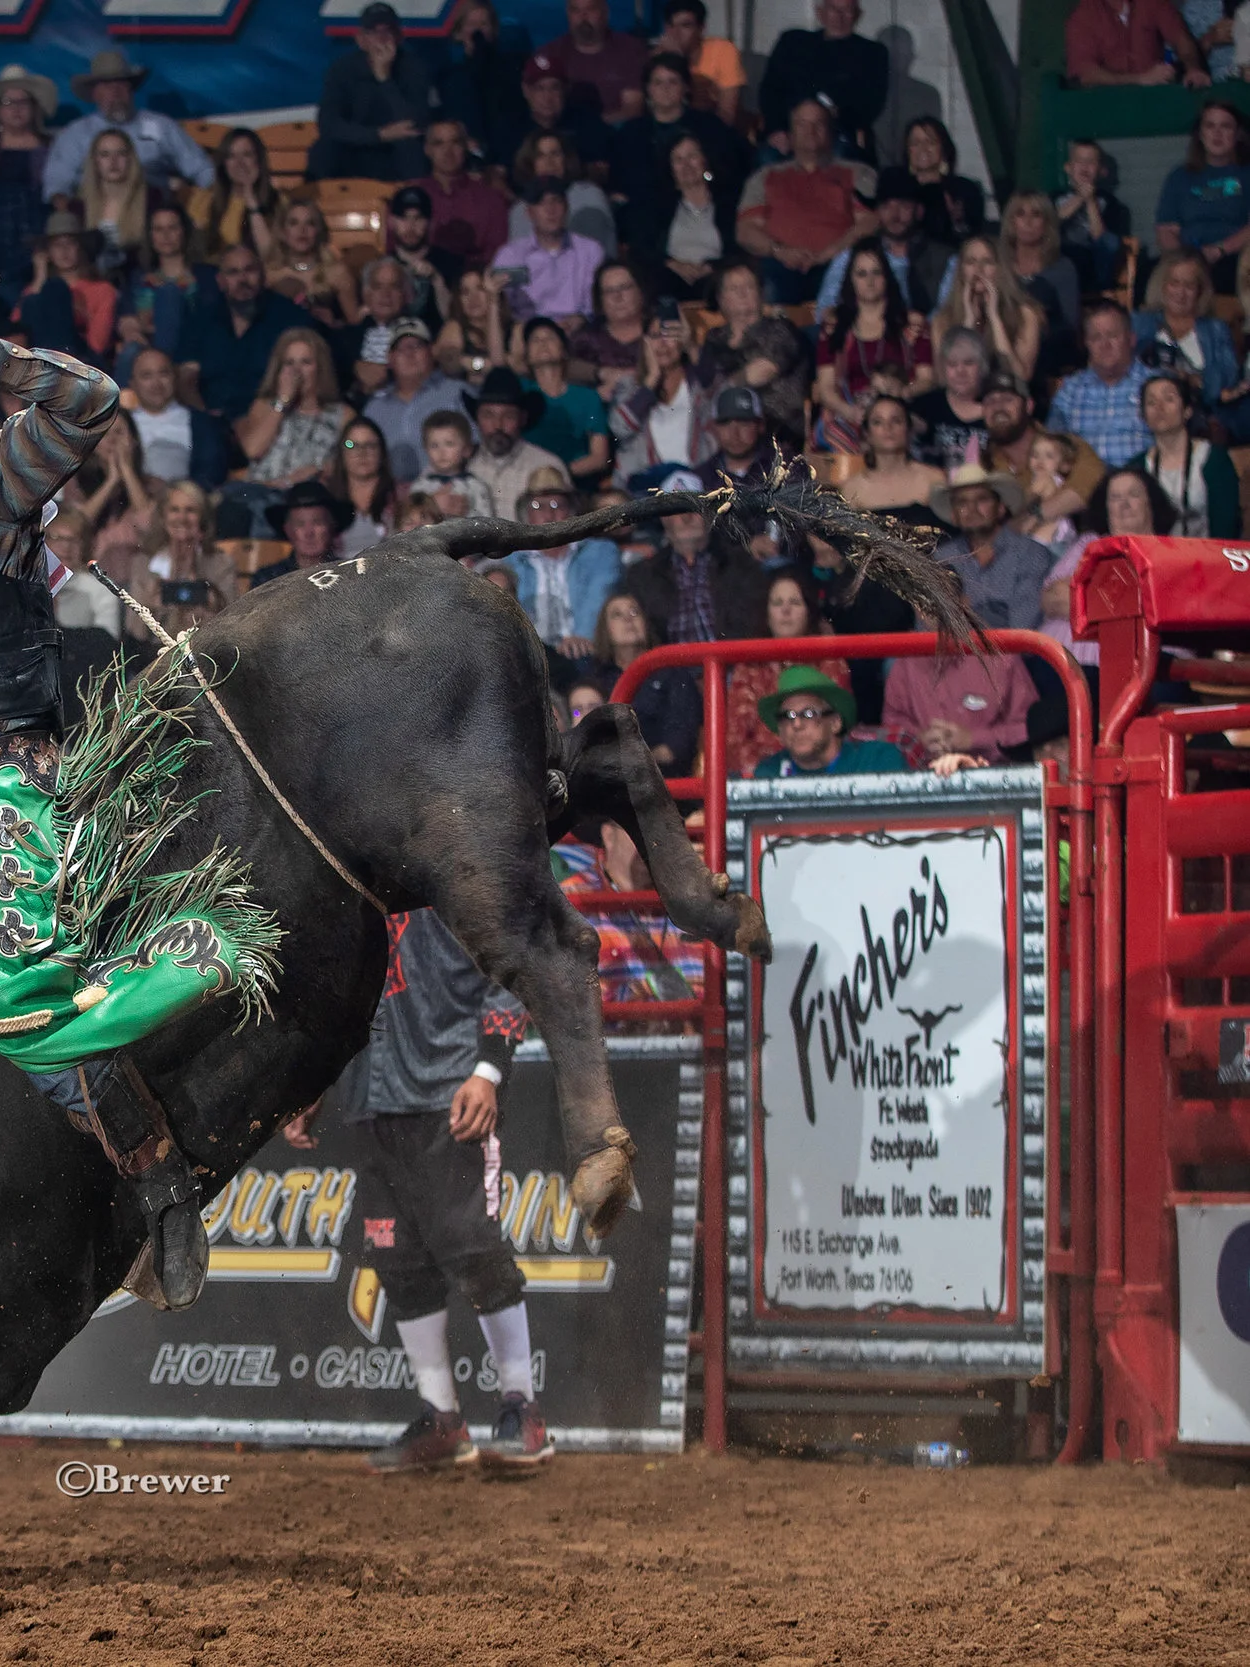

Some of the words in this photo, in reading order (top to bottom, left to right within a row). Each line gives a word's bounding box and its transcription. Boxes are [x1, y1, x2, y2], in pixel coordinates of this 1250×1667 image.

[789, 855, 948, 1126] Fincher's
[200, 1167, 356, 1248] OUTH
[965, 1186, 992, 1218] 1902
[782, 1229, 801, 1254] 115
[818, 1230, 873, 1259] Exchange
[877, 1232, 900, 1254] Ave.
[780, 1265, 801, 1290] Fort
[844, 1267, 875, 1290] Texas
[879, 1267, 912, 1292] 76106
[149, 1342, 281, 1387] HOTEL
[315, 1344, 422, 1390] CASIN
